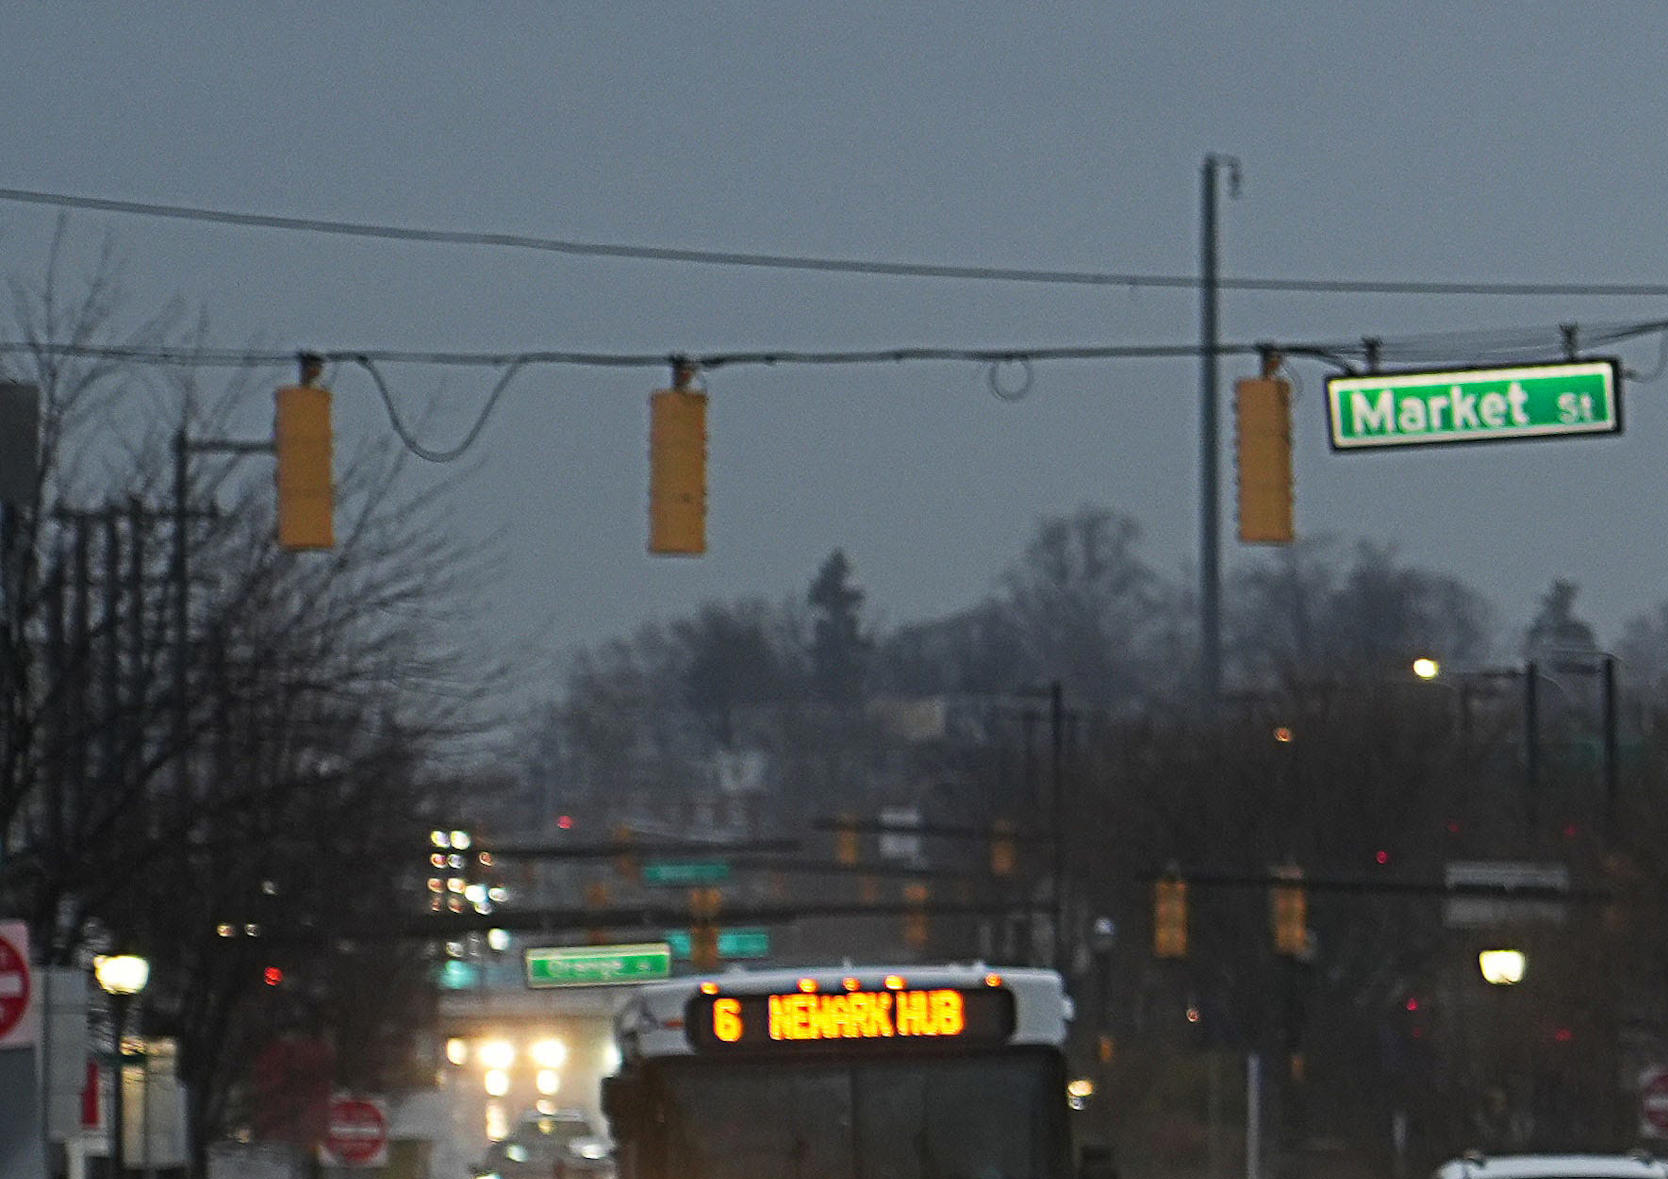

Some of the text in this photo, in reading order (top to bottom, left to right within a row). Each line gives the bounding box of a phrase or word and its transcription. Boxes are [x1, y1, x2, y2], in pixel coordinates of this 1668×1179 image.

[1350, 381, 1595, 436] Market St
[713, 988, 965, 1042] 6 NEWARK HUB
